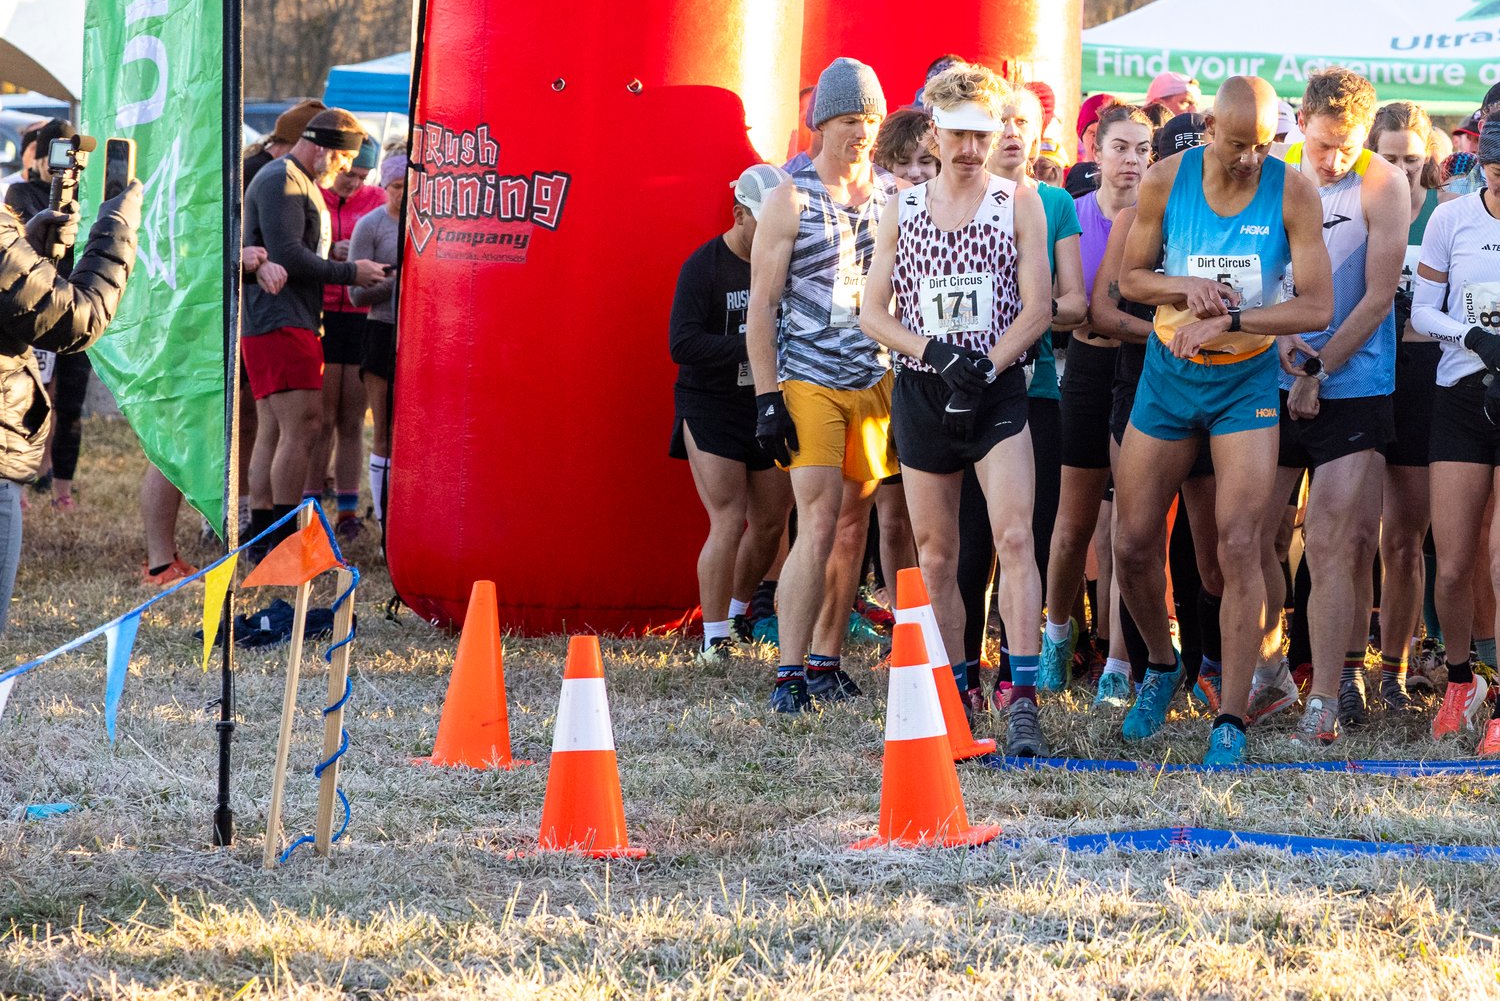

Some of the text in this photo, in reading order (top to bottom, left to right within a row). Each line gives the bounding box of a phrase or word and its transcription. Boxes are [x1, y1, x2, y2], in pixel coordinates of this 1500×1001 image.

[1096, 47, 1169, 77] Find
[1182, 55, 1265, 86] your
[1274, 53, 1465, 86] Adenture
[425, 121, 500, 168] Rush
[410, 170, 572, 236] unning
[437, 227, 529, 249] Company
[1240, 225, 1269, 235] HOKA
[1197, 257, 1251, 268] Dirt Circus
[843, 276, 859, 286] Dirt
[929, 276, 983, 289] Dirt Circus
[932, 290, 978, 320] 171
[1465, 292, 1477, 324] Circus
[1256, 407, 1278, 418] HOKA
